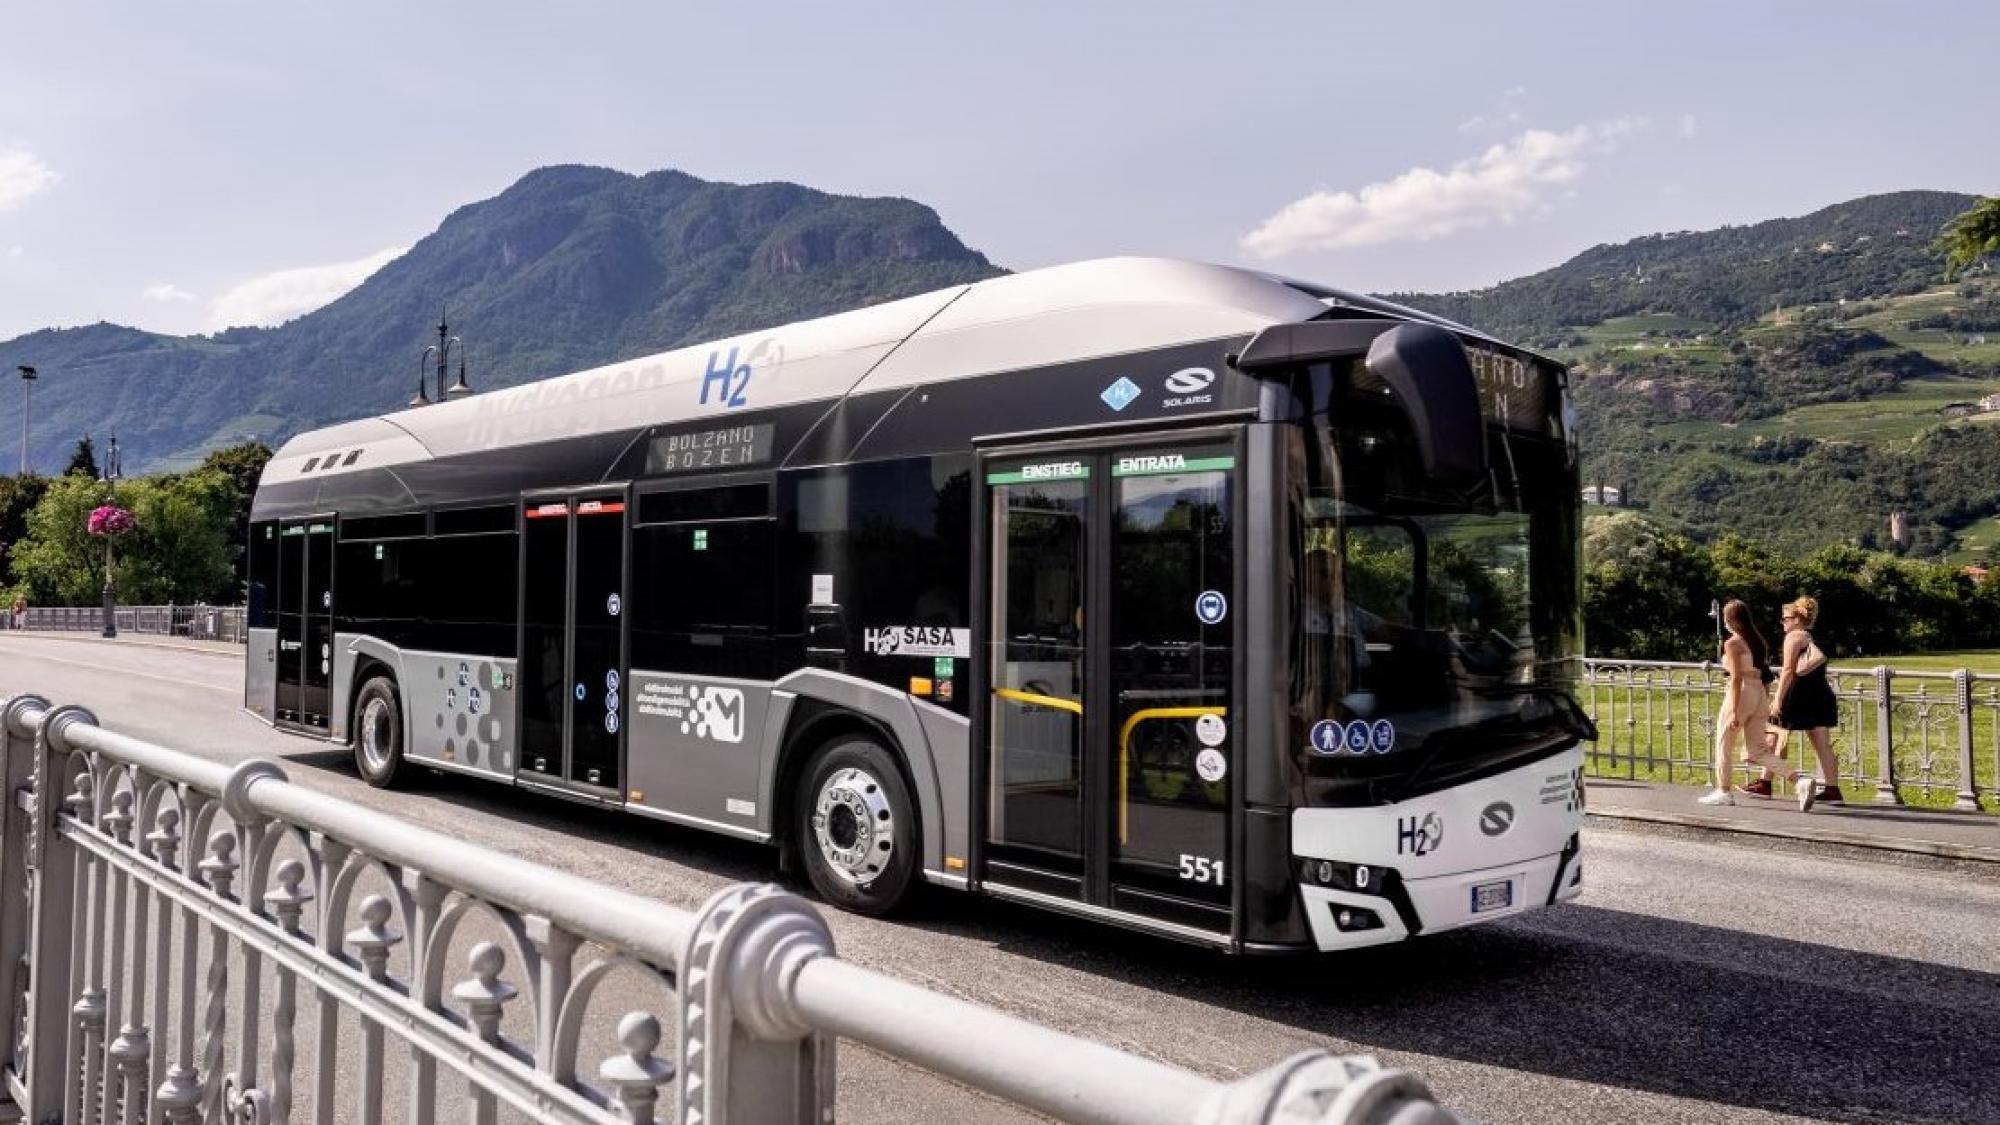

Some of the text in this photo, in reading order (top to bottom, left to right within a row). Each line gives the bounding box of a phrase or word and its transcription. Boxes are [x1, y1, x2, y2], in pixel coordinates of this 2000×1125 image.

[700, 346, 751, 407] H2
[1163, 394, 1212, 408] SOLARIS
[669, 426, 754, 451] BOLZANO
[665, 445, 753, 469] BOZEN
[1119, 455, 1186, 473] ENTRATA
[1022, 462, 1082, 479] EINSTIEG
[903, 627, 955, 646] SASA
[1179, 854, 1225, 886] 551
